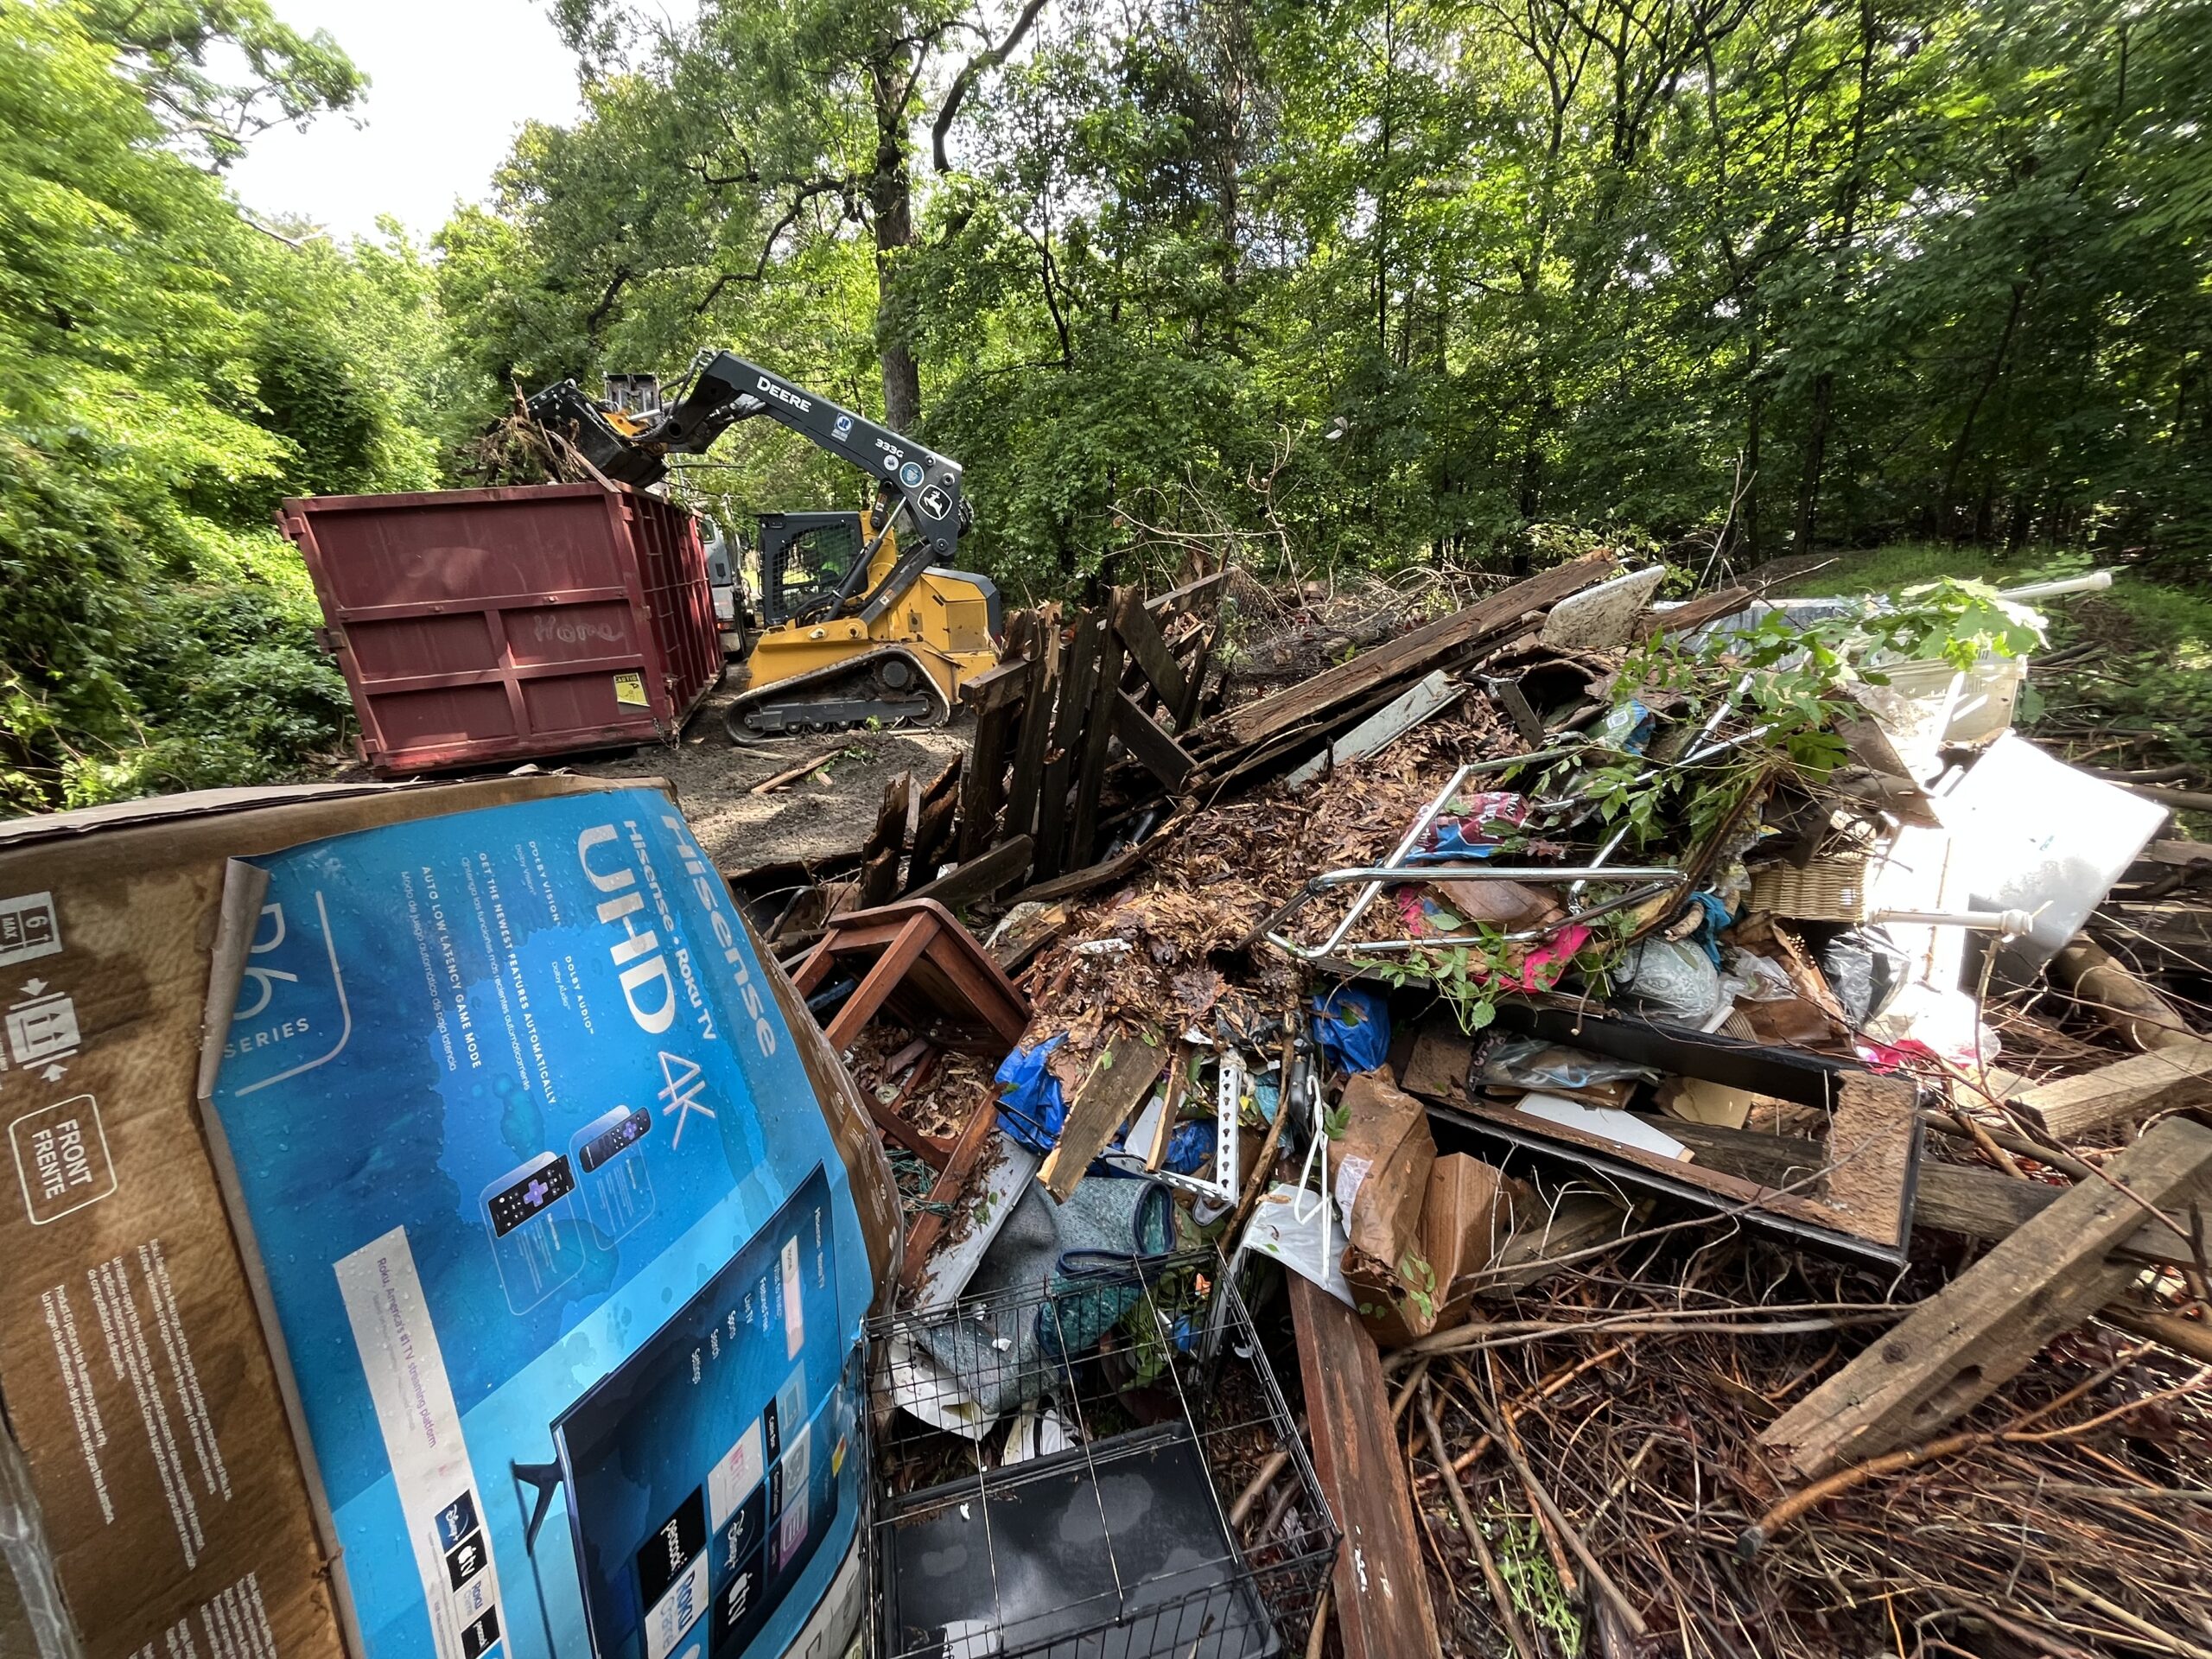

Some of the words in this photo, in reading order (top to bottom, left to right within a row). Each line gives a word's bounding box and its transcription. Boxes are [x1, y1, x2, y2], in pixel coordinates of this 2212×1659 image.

[757, 375, 811, 413] DEERE
[874, 436, 904, 459] 333G
[514, 843, 527, 868] Dolby
[529, 840, 546, 879] DOLBY
[400, 870, 416, 899] Modo
[421, 865, 438, 900] AUTO
[407, 899, 418, 913] de
[431, 903, 447, 931] LOW
[473, 896, 483, 910] las
[1, 917, 17, 939] MAX
[25, 913, 49, 931] 6
[409, 913, 425, 942] juego
[476, 910, 494, 954] funciones
[577, 823, 677, 1034] UHD
[623, 819, 677, 934] Hisense
[696, 1009, 717, 1041] TV
[660, 814, 776, 1058] Hisense
[438, 935, 461, 990] LATENCY
[478, 852, 492, 875] GET
[486, 878, 499, 900] THE
[493, 903, 513, 950] NEWEST
[505, 953, 530, 1009] FEATURES
[524, 1012, 557, 1106] AUTOMATICALLY
[488, 954, 500, 974] más
[550, 961, 563, 984] Dolby
[564, 955, 581, 991] DOLBY
[432, 997, 442, 1010] de
[454, 993, 471, 1029] GAME
[493, 974, 510, 1014] recientes
[224, 1017, 311, 1059] SERIES
[440, 1033, 458, 1071] latencia
[463, 1033, 481, 1069] MODE
[657, 1050, 716, 1151] 4K
[31, 1128, 67, 1200] FRENTE
[56, 1118, 93, 1185] FRONT
[375, 1257, 393, 1287] Roku,
[384, 1287, 407, 1334] America's
[727, 1310, 736, 1340] Sports
[402, 1345, 414, 1360] TV
[710, 1328, 719, 1360] Search
[404, 1362, 429, 1409] streaming
[418, 1408, 439, 1448] platform
